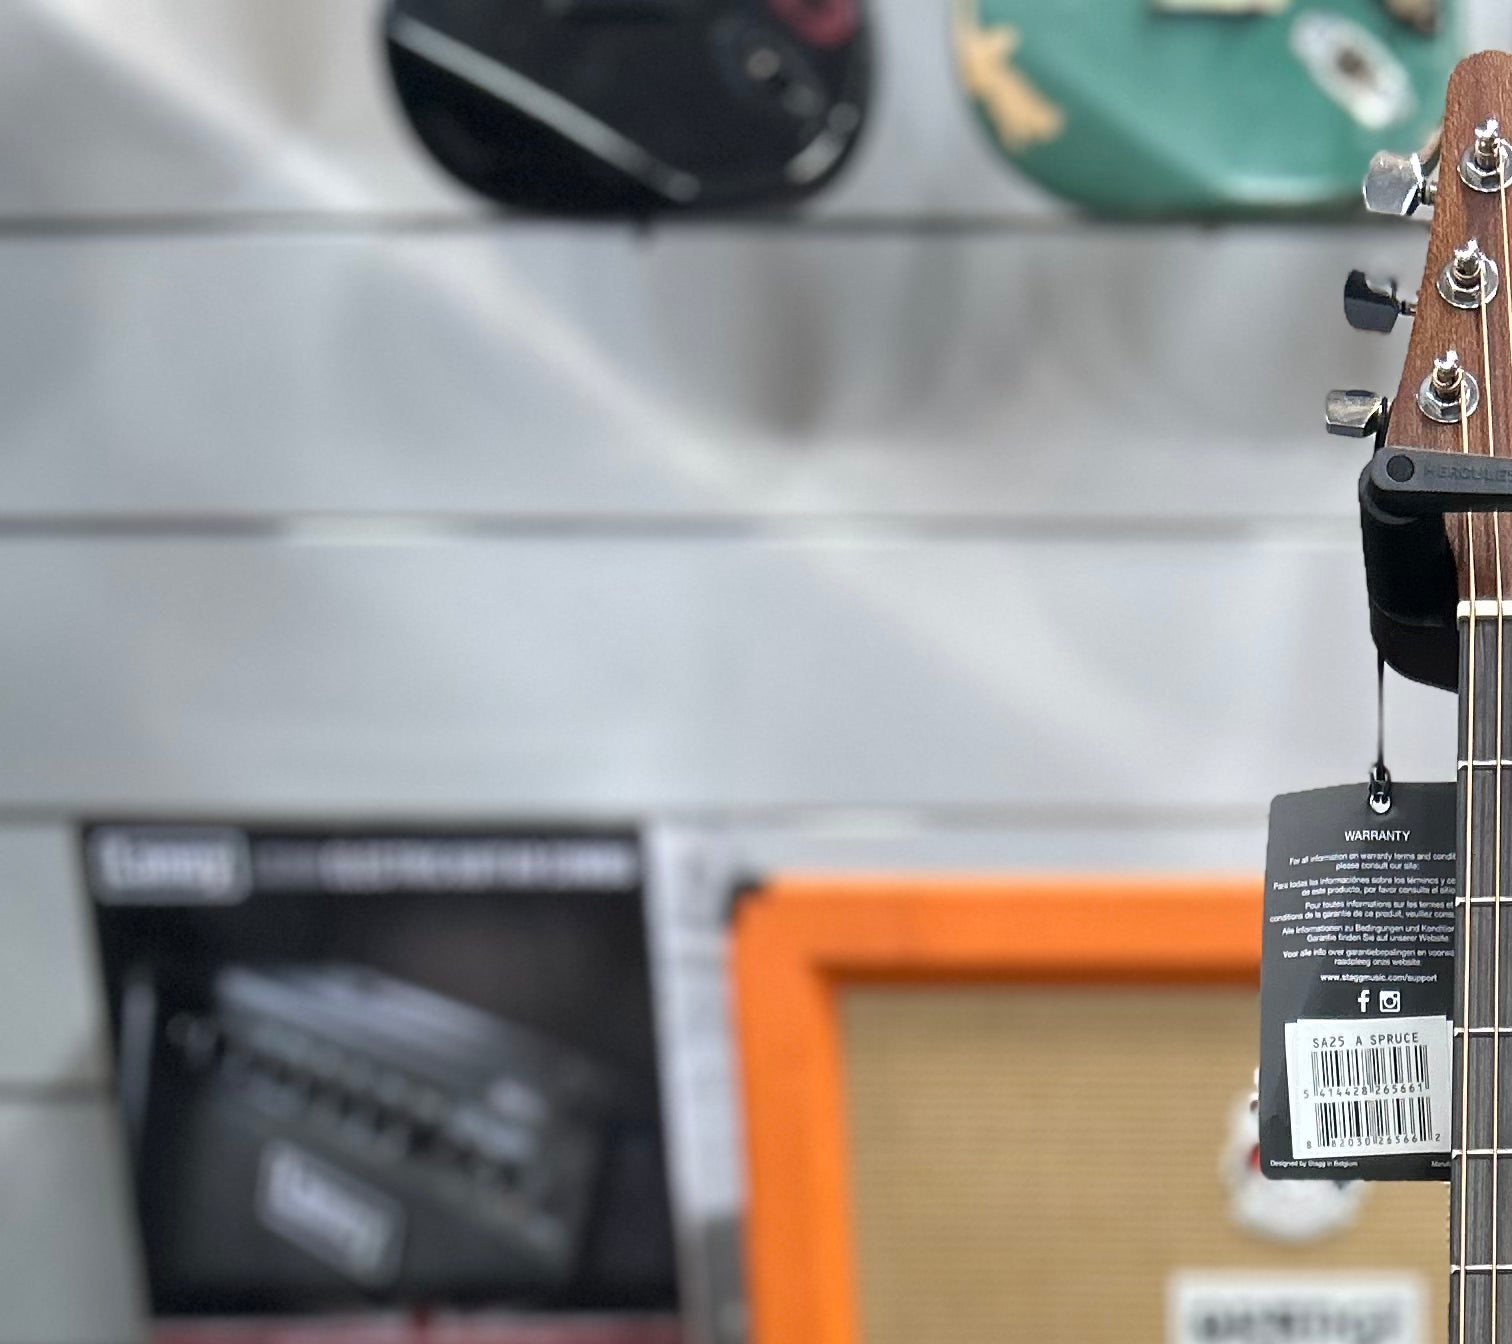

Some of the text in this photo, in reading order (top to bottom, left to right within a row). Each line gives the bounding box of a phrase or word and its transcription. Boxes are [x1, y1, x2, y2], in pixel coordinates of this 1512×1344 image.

[1344, 830, 1410, 842] WARRANTY
[1289, 857, 1300, 865] For
[1360, 852, 1392, 861] warranty
[1417, 852, 1431, 860] and
[1336, 862, 1359, 871] please
[1371, 876, 1392, 884] sobre
[1440, 878, 1445, 886] y
[1270, 914, 1303, 922] conditions
[1355, 924, 1404, 933] Bedingungen
[1307, 934, 1336, 942] Garantie
[1376, 933, 1388, 941] auf
[1313, 1032, 1419, 1048] SA25 A SPRUCE
[1304, 1083, 1422, 1099] 5 414428 265661
[1306, 1133, 1440, 1149] 8 82030 26566 2
[1270, 1160, 1298, 1168] Designed
[1299, 1160, 1307, 1168] by
